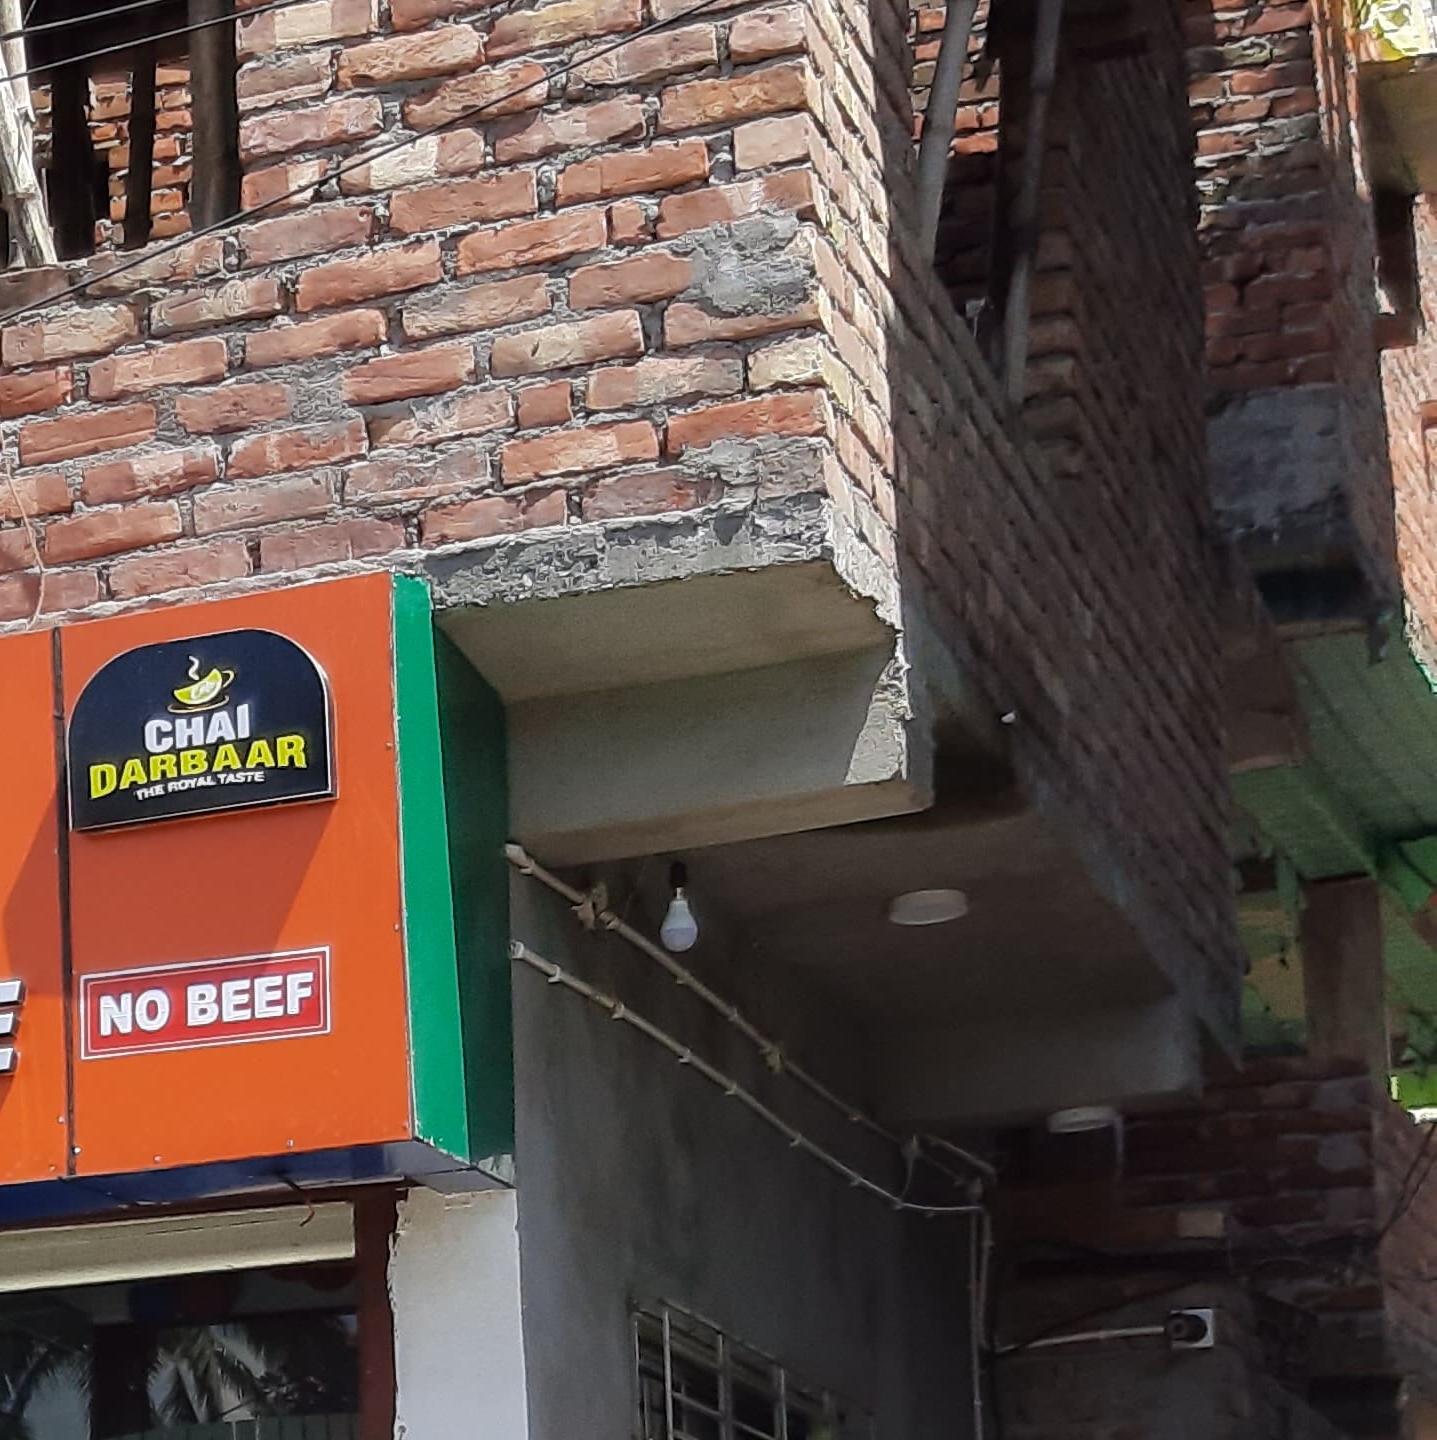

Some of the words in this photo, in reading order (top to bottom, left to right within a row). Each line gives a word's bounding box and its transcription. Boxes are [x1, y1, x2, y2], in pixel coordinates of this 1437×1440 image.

[144, 704, 250, 753] CHAI
[89, 734, 308, 799] DARBAAR
[133, 784, 165, 801] THE
[167, 774, 217, 792] ROYAL
[218, 770, 266, 785] TASTE
[99, 988, 171, 1037] NO
[186, 971, 315, 1027] BEEF
